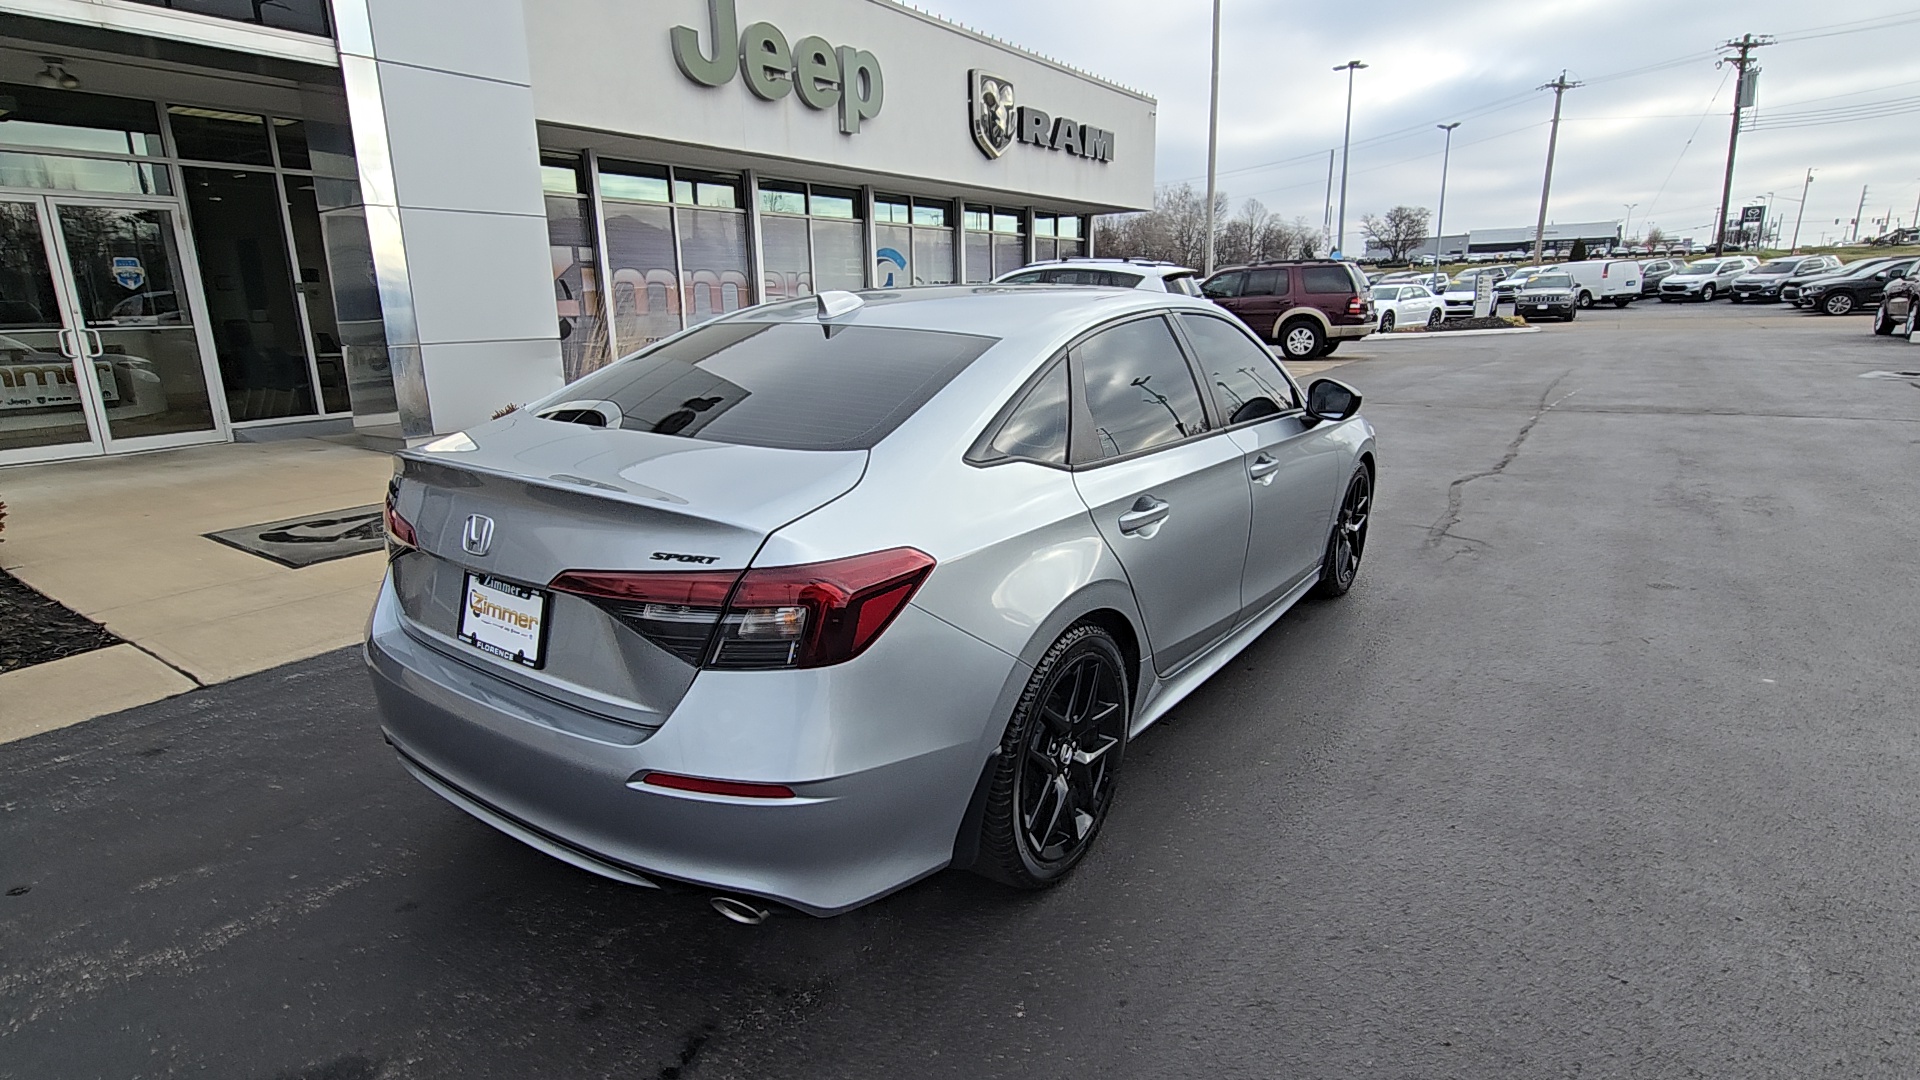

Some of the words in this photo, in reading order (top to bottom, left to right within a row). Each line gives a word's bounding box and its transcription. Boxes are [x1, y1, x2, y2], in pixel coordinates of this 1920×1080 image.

[671, 0, 884, 134] Jeep
[1017, 106, 1115, 162] RAM
[649, 552, 721, 564] SPORT
[483, 574, 521, 596] Zimmer
[472, 592, 539, 630] Zimmer
[476, 640, 514, 661] FLORENCE
